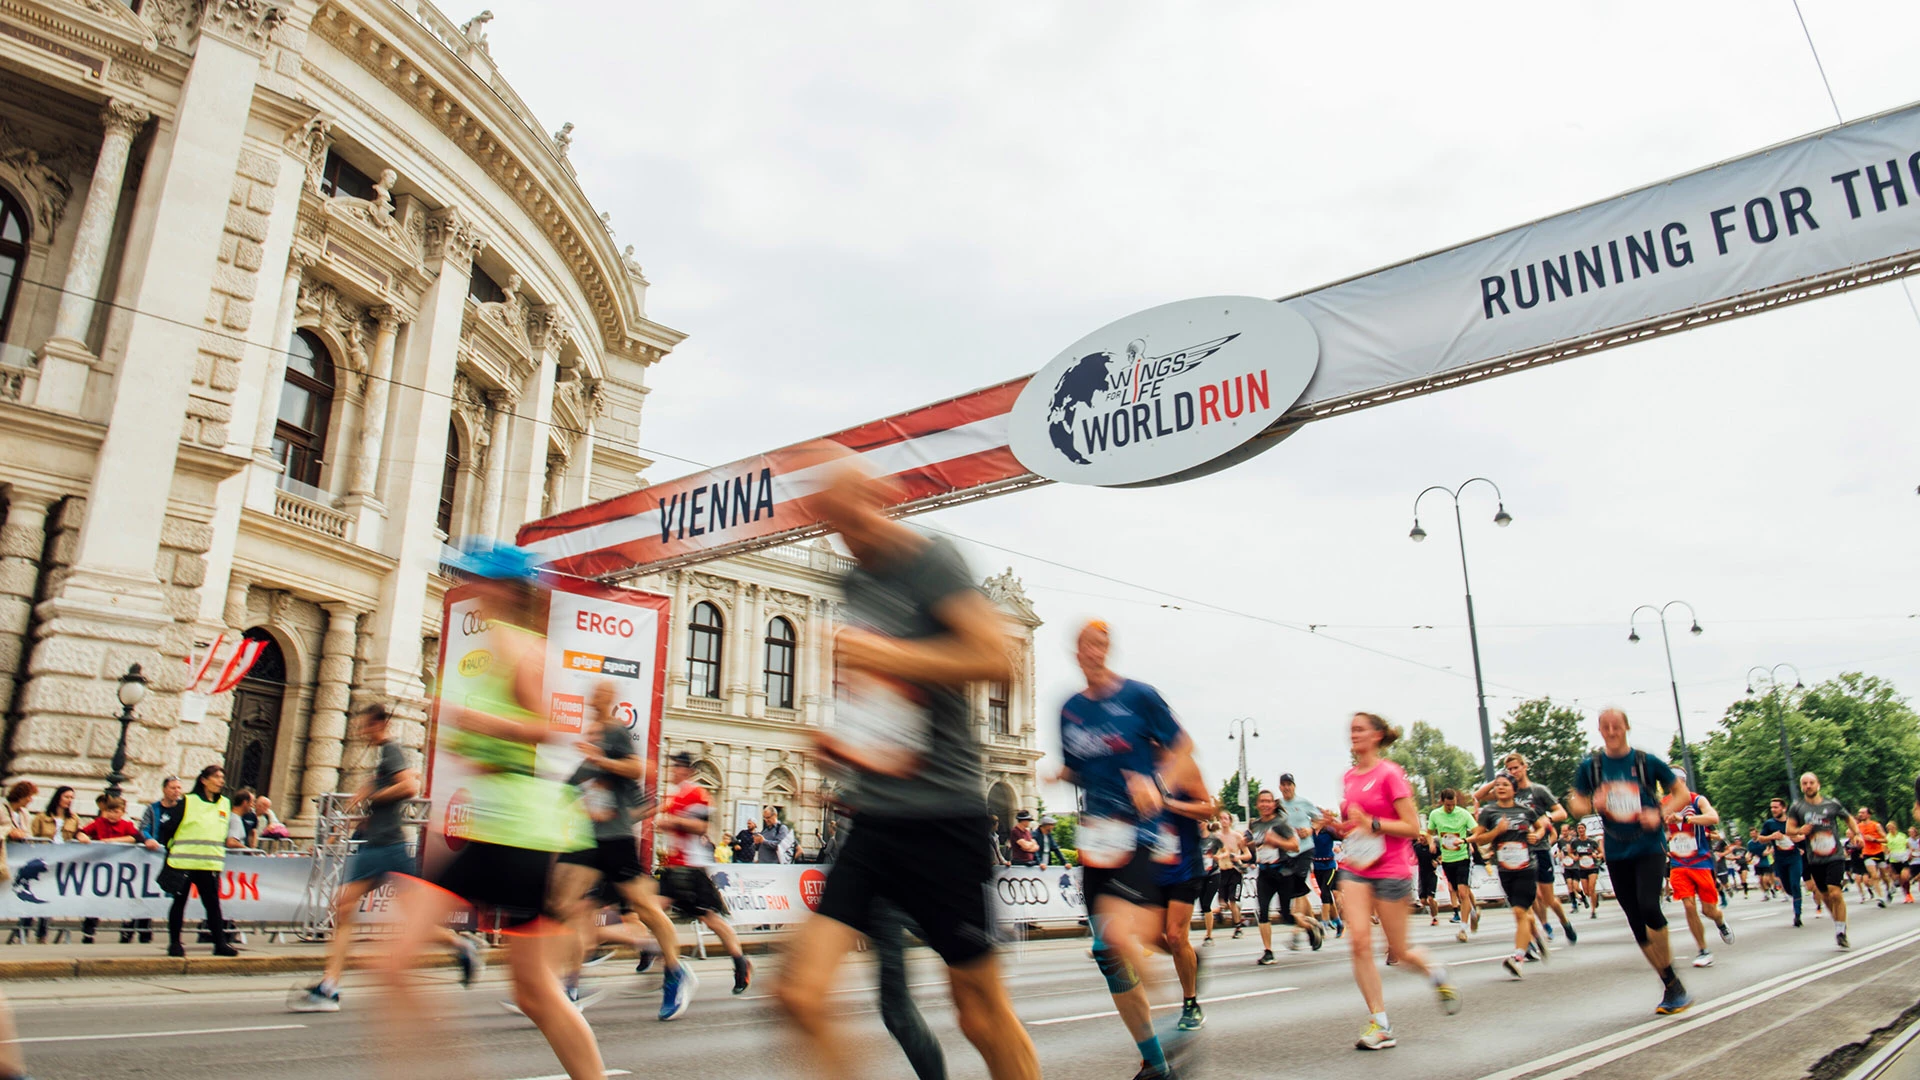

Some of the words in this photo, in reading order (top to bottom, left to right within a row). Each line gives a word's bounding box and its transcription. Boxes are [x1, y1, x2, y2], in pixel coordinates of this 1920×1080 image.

[1479, 221, 1694, 319] RUNNING
[1710, 186, 1819, 256] FOR
[1110, 353, 1186, 391] WINGS
[1105, 390, 1121, 401] FOR
[1120, 377, 1164, 407] LIFE
[659, 467, 775, 544] VIENNA
[576, 610, 634, 638] ERGO
[552, 712, 581, 728] Zeitung
[553, 697, 582, 713] Kronen
[56, 861, 173, 899] WORL
[803, 880, 826, 895] JETZ
